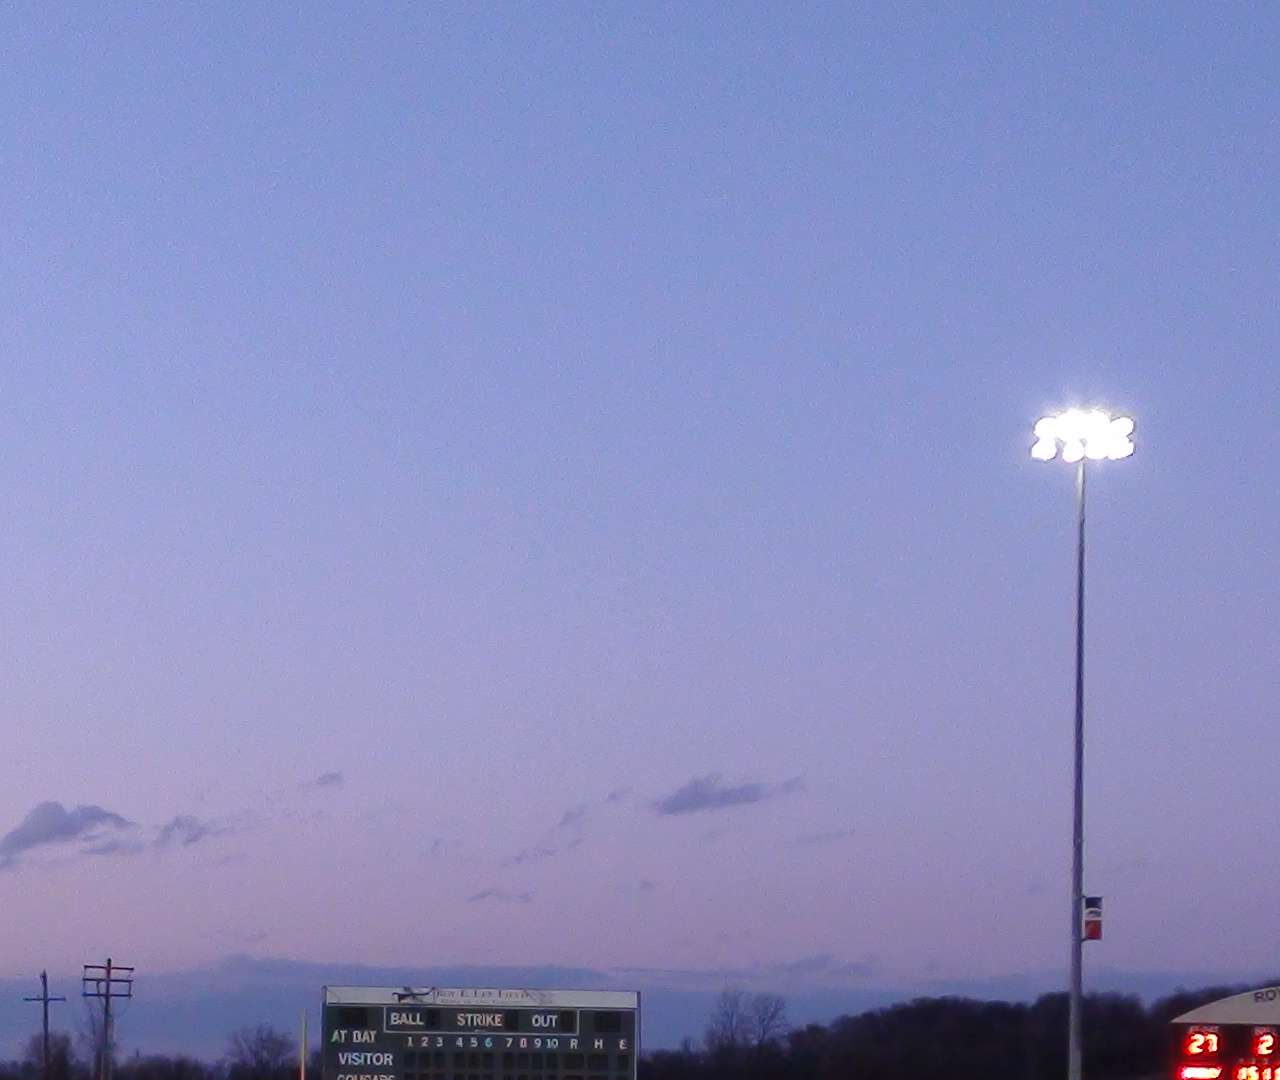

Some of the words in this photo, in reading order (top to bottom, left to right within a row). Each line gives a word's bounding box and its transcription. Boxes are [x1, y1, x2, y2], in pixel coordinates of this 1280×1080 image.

[390, 1012, 424, 1025] BALL
[457, 1013, 503, 1027] STRIKE
[531, 1014, 558, 1028] OUT
[331, 1029, 347, 1043] AT
[352, 1030, 377, 1043] BAT
[1257, 1034, 1274, 1055] 2
[338, 1052, 393, 1066] VISITOR
